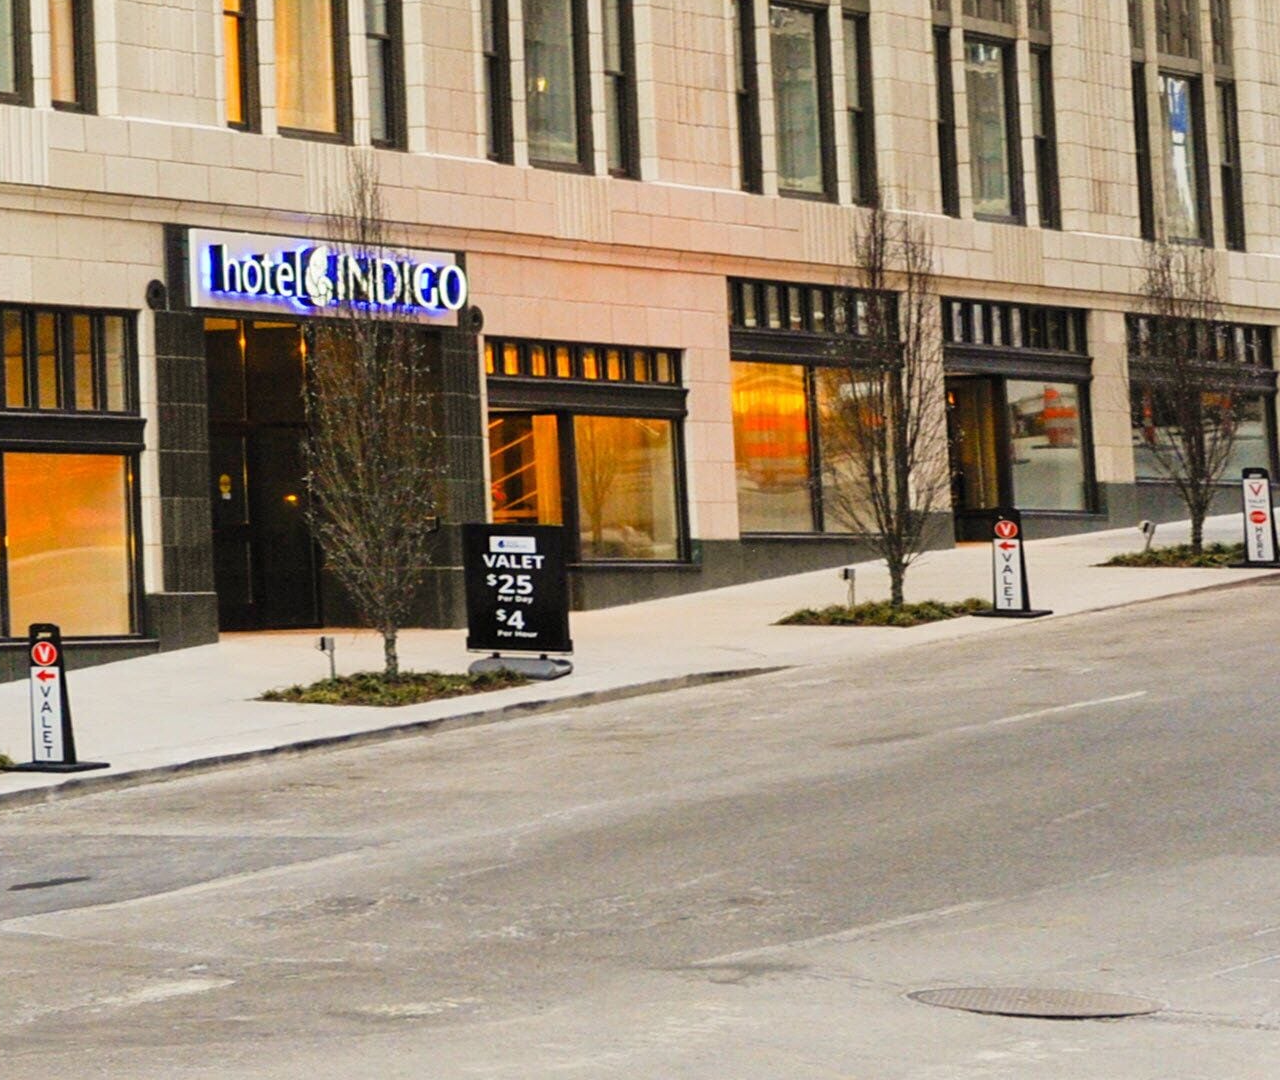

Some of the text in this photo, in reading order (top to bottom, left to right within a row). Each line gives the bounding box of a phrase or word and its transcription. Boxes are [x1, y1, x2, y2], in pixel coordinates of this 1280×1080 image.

[220, 243, 468, 311] hotel INDIGO
[1000, 523, 1012, 536] V
[482, 554, 545, 569] VALET
[486, 573, 534, 595] $25
[1002, 552, 1013, 607] VALET
[497, 594, 534, 605] Per Day
[495, 609, 526, 630] $4
[37, 645, 51, 662] V
[40, 685, 53, 758] VALET
